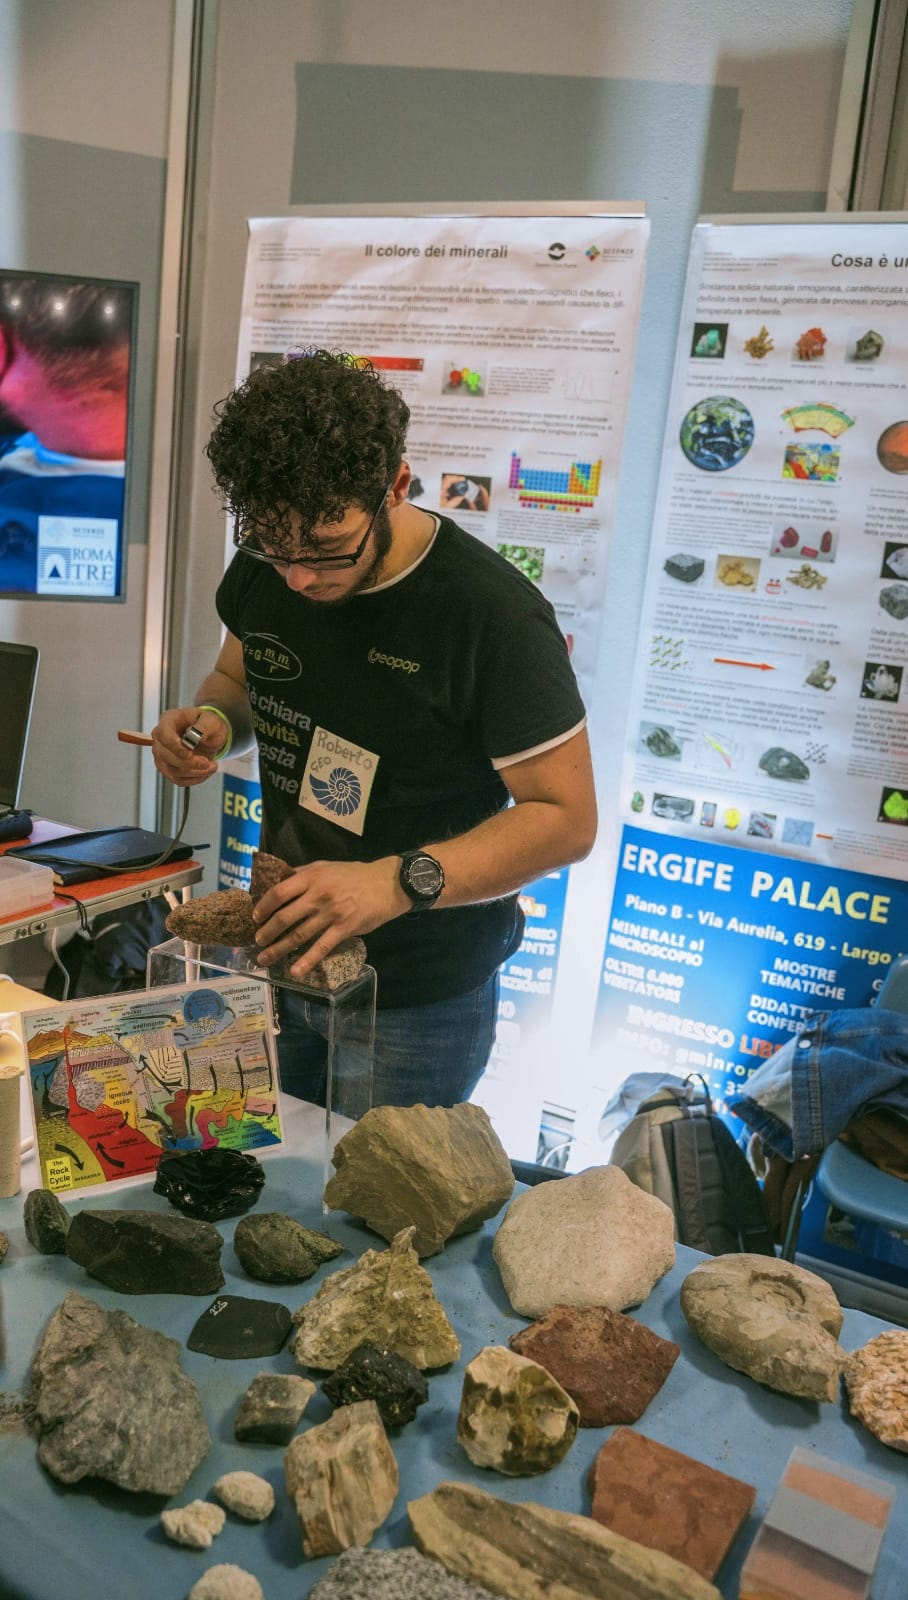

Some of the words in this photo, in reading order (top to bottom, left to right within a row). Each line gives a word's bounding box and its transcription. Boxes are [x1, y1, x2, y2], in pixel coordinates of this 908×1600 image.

[364, 245, 373, 257] Il
[376, 245, 420, 257] colore
[424, 245, 445, 257] dei
[449, 245, 508, 259] minerali
[831, 253, 873, 268] Cosa
[879, 253, 888, 268] è
[72, 547, 114, 562] ROMA
[72, 564, 114, 581] TRE
[258, 695, 311, 732] chiara
[317, 730, 373, 771] Roberto
[223, 790, 262, 824] ERG
[622, 842, 735, 893] ERGIFE
[750, 870, 891, 924] PALACE
[611, 917, 686, 949] MINERALI
[625, 893, 668, 916] Piano
[671, 904, 683, 919] B
[698, 909, 724, 929] Via
[726, 916, 789, 945] Aurelia,
[793, 932, 826, 952] 619
[842, 942, 892, 966] Largo
[609, 933, 703, 967] MICROSCOPIO
[604, 956, 645, 979] OLTRE
[773, 957, 837, 983] MOSTRE
[603, 971, 682, 1004] VISITATORI
[759, 969, 847, 1001] TEMATICHE
[750, 994, 814, 1018] DIDATT
[626, 1003, 736, 1049] INGRESSO
[739, 1033, 784, 1059] LIB
[746, 1009, 807, 1034] CONFER
[49, 1166, 70, 1176] Rock
[49, 1174, 71, 1186] Cycle
